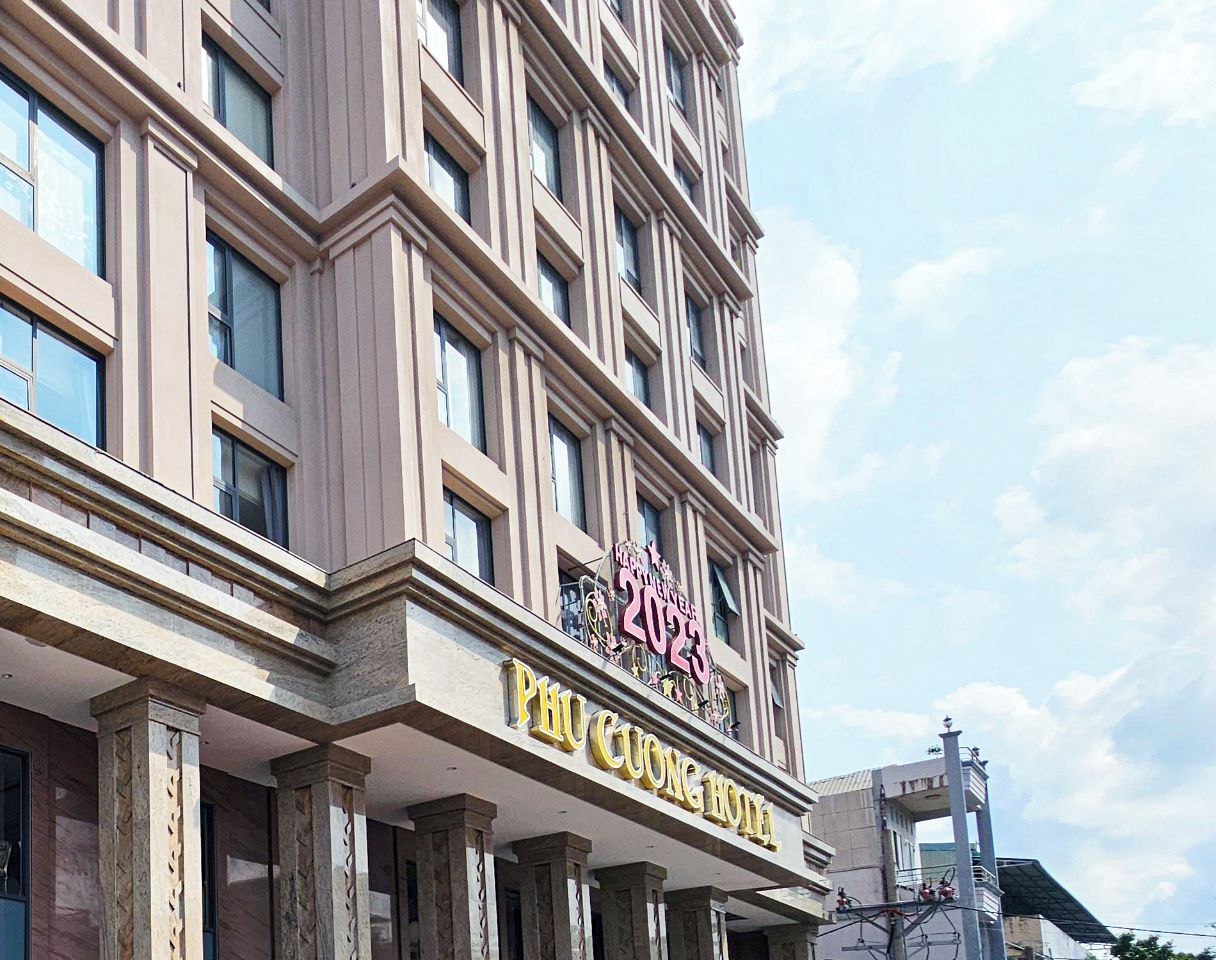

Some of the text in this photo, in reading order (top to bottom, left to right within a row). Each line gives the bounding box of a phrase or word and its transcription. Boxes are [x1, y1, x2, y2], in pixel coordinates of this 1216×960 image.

[614, 542, 697, 621] HAPPY NEW YEAR
[616, 568, 710, 686] 2023
[508, 657, 782, 853] PHU CUONG HOTEL
